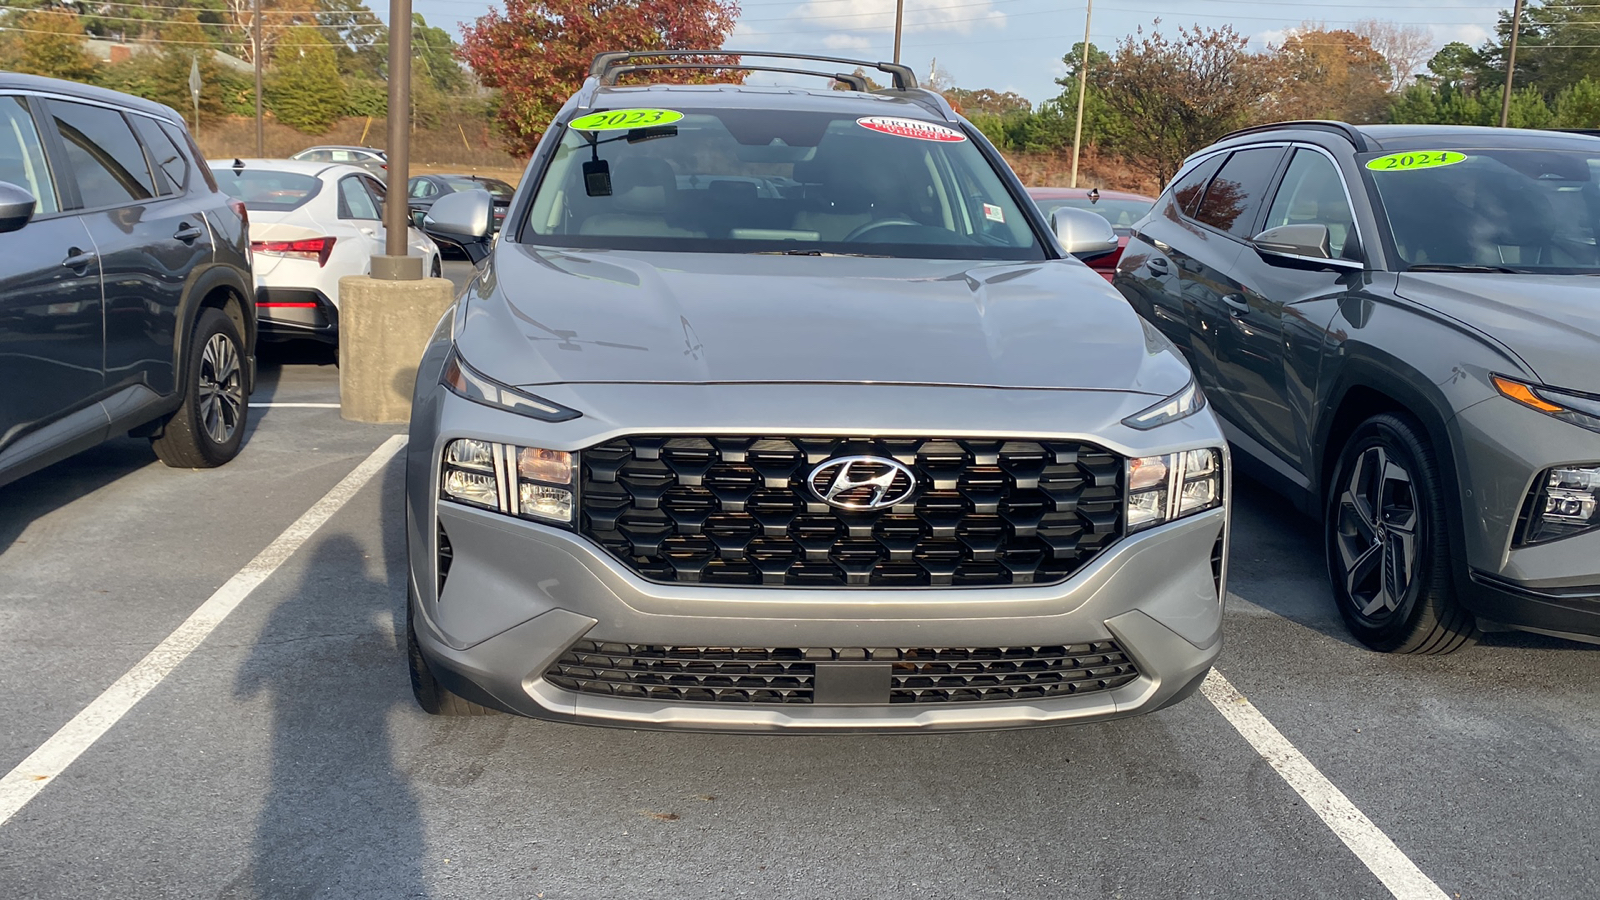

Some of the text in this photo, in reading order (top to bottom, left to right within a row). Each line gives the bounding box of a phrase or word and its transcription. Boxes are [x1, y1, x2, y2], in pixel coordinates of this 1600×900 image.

[587, 111, 664, 128] 2023
[869, 117, 953, 135] CERTIFIED
[1384, 152, 1448, 169] 2024
